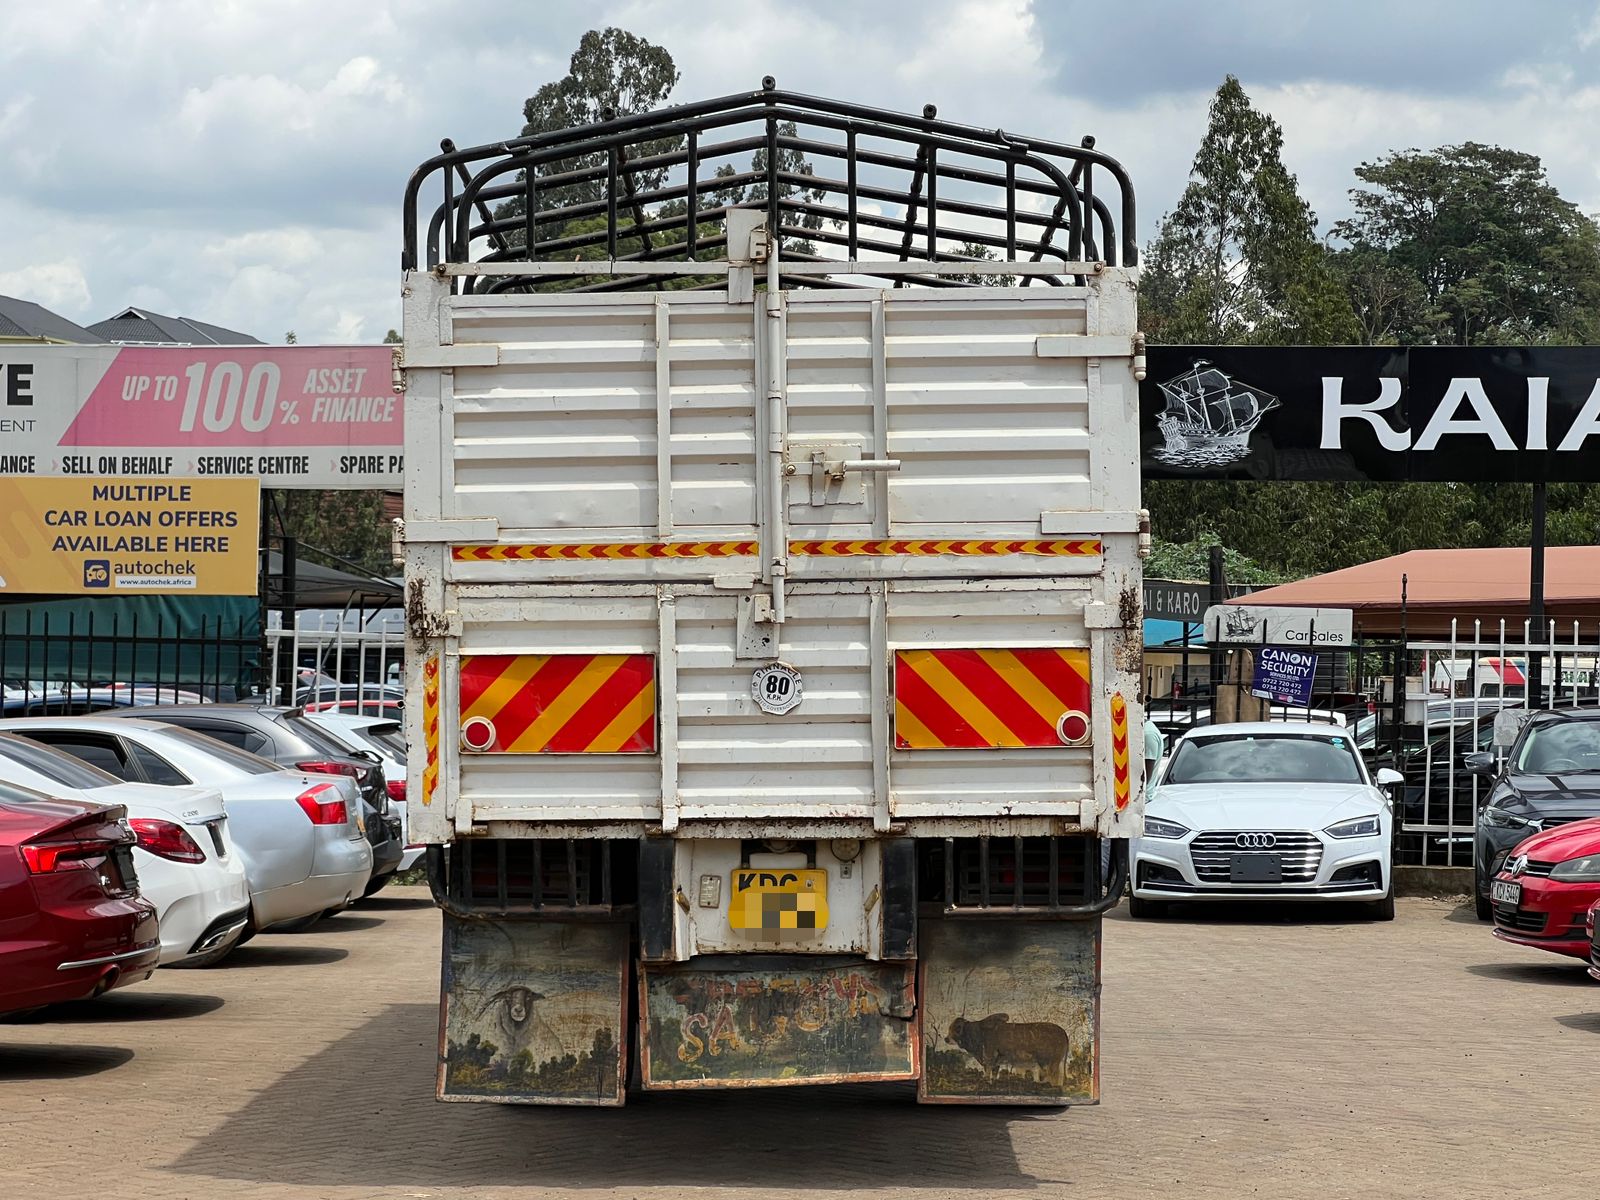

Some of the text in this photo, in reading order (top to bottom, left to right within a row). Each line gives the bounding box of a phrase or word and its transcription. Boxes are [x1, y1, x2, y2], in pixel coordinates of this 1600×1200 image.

[0, 364, 33, 405] E
[121, 375, 149, 401] UP
[154, 375, 178, 401] TO
[302, 368, 367, 394] ASSET
[311, 397, 396, 423] FINANCE
[0, 420, 36, 432] ENT
[62, 456, 173, 474] SELL ON BEHALF
[197, 456, 309, 474] SERVICE CENTRE
[340, 456, 384, 474] SPARE
[93, 485, 192, 501] MULTIPLE
[44, 510, 238, 527] CAR LOAN OFFERS
[51, 536, 229, 552] AVAILABLE HERE
[114, 560, 196, 575] autochek
[120, 578, 192, 587] www.autochek.africa
[1156, 590, 1163, 612] &
[1167, 591, 1200, 615] KARO
[1285, 630, 1344, 642] Car Sales
[1261, 648, 1312, 667] CANON
[755, 662, 802, 685] PINNACLE
[1260, 660, 1310, 677] SECURITY
[766, 675, 790, 695] 80
[1262, 677, 1278, 685] 0722
